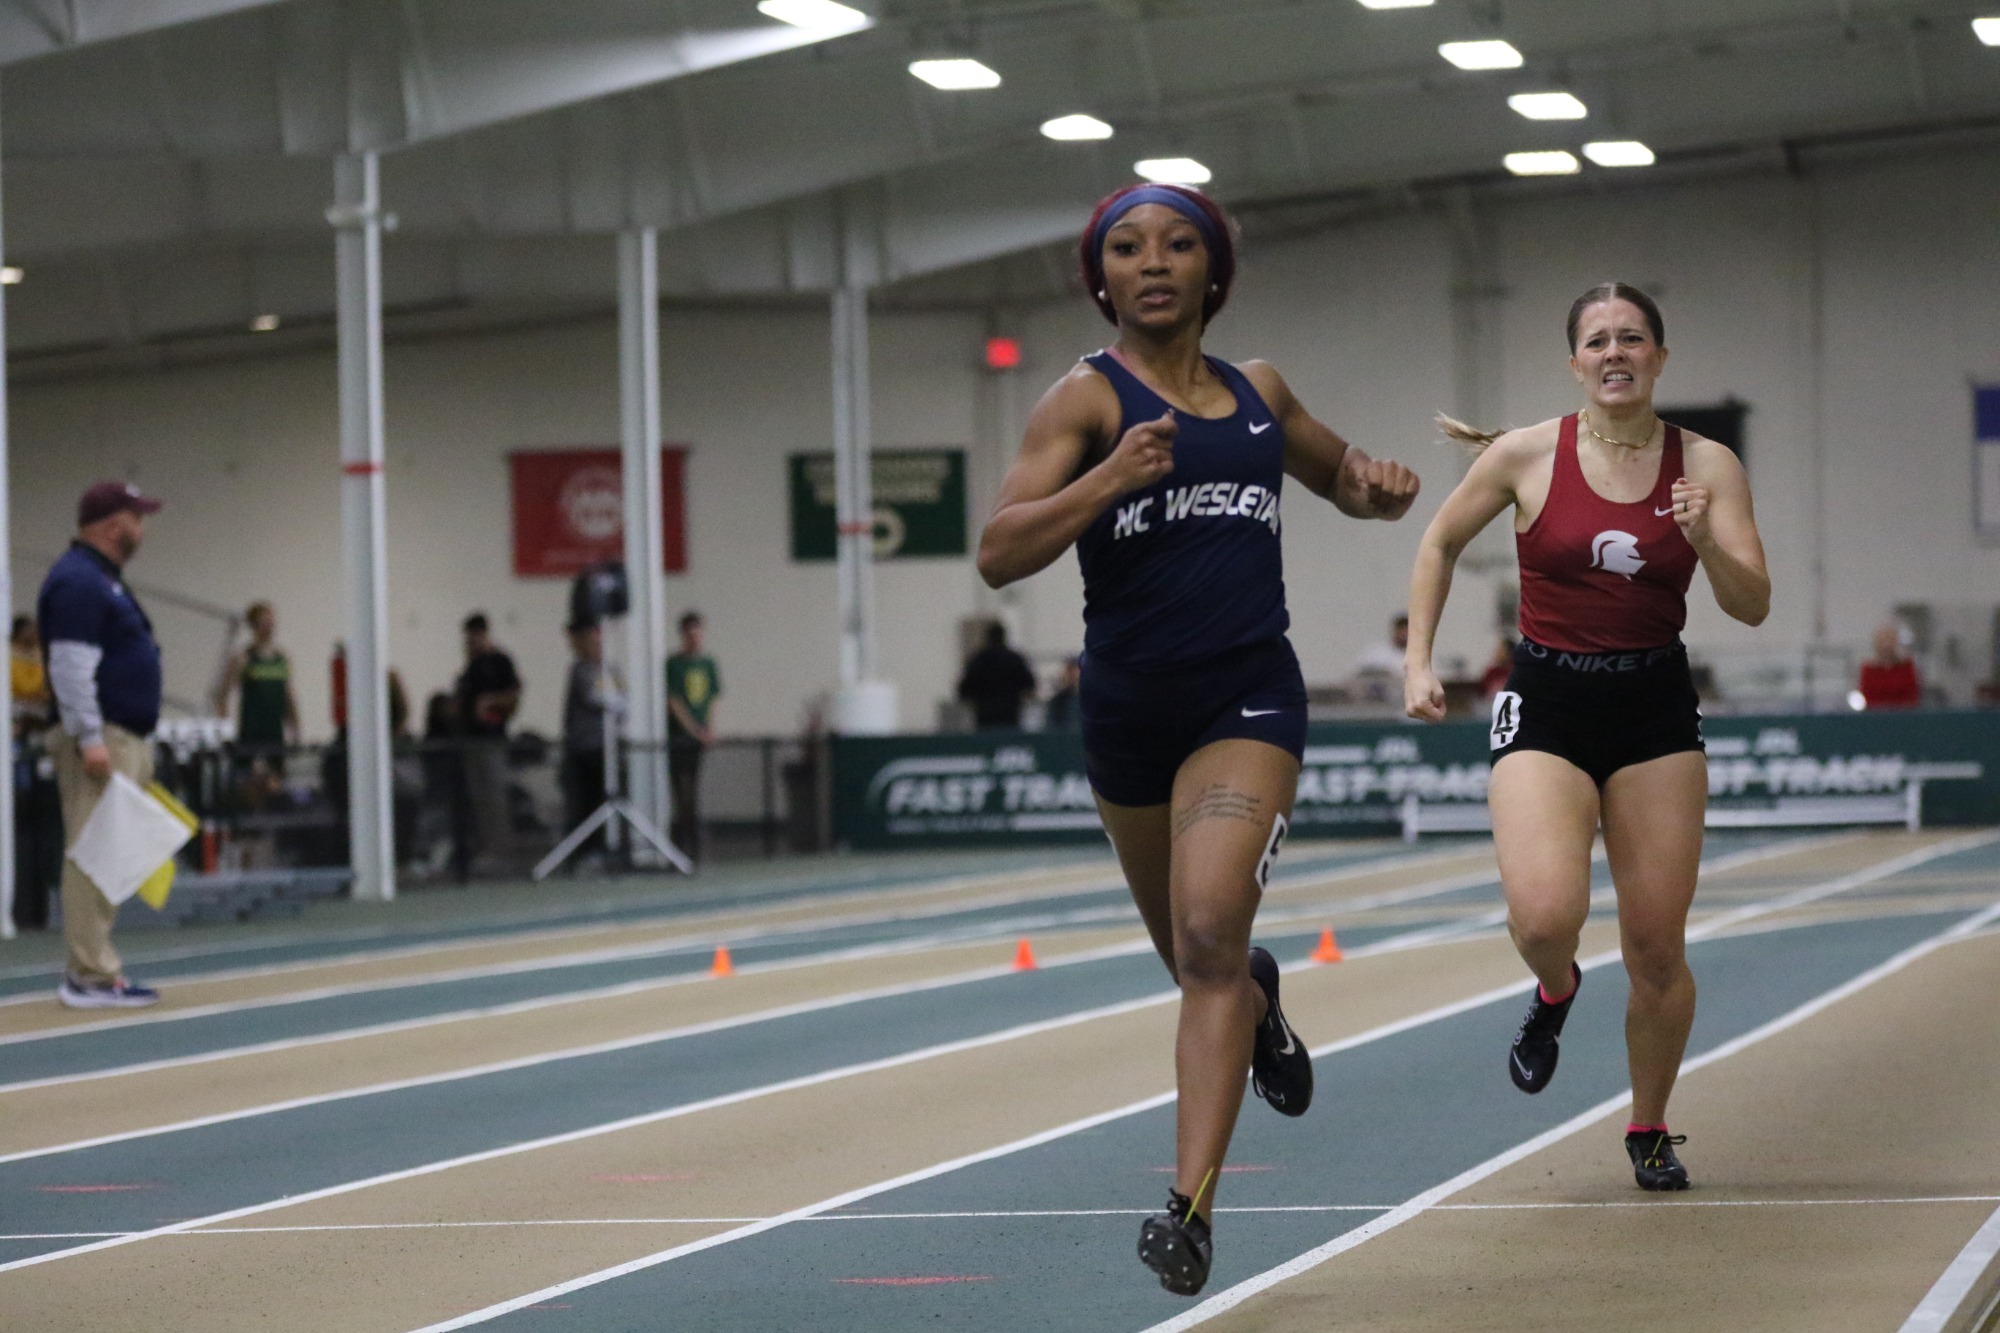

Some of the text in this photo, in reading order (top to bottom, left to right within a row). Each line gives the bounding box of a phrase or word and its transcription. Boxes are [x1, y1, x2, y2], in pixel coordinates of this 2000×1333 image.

[1114, 496, 1154, 540] NC
[1556, 652, 1641, 673] NIKE
[1492, 695, 1514, 744] 4
[885, 772, 990, 812] FAST
